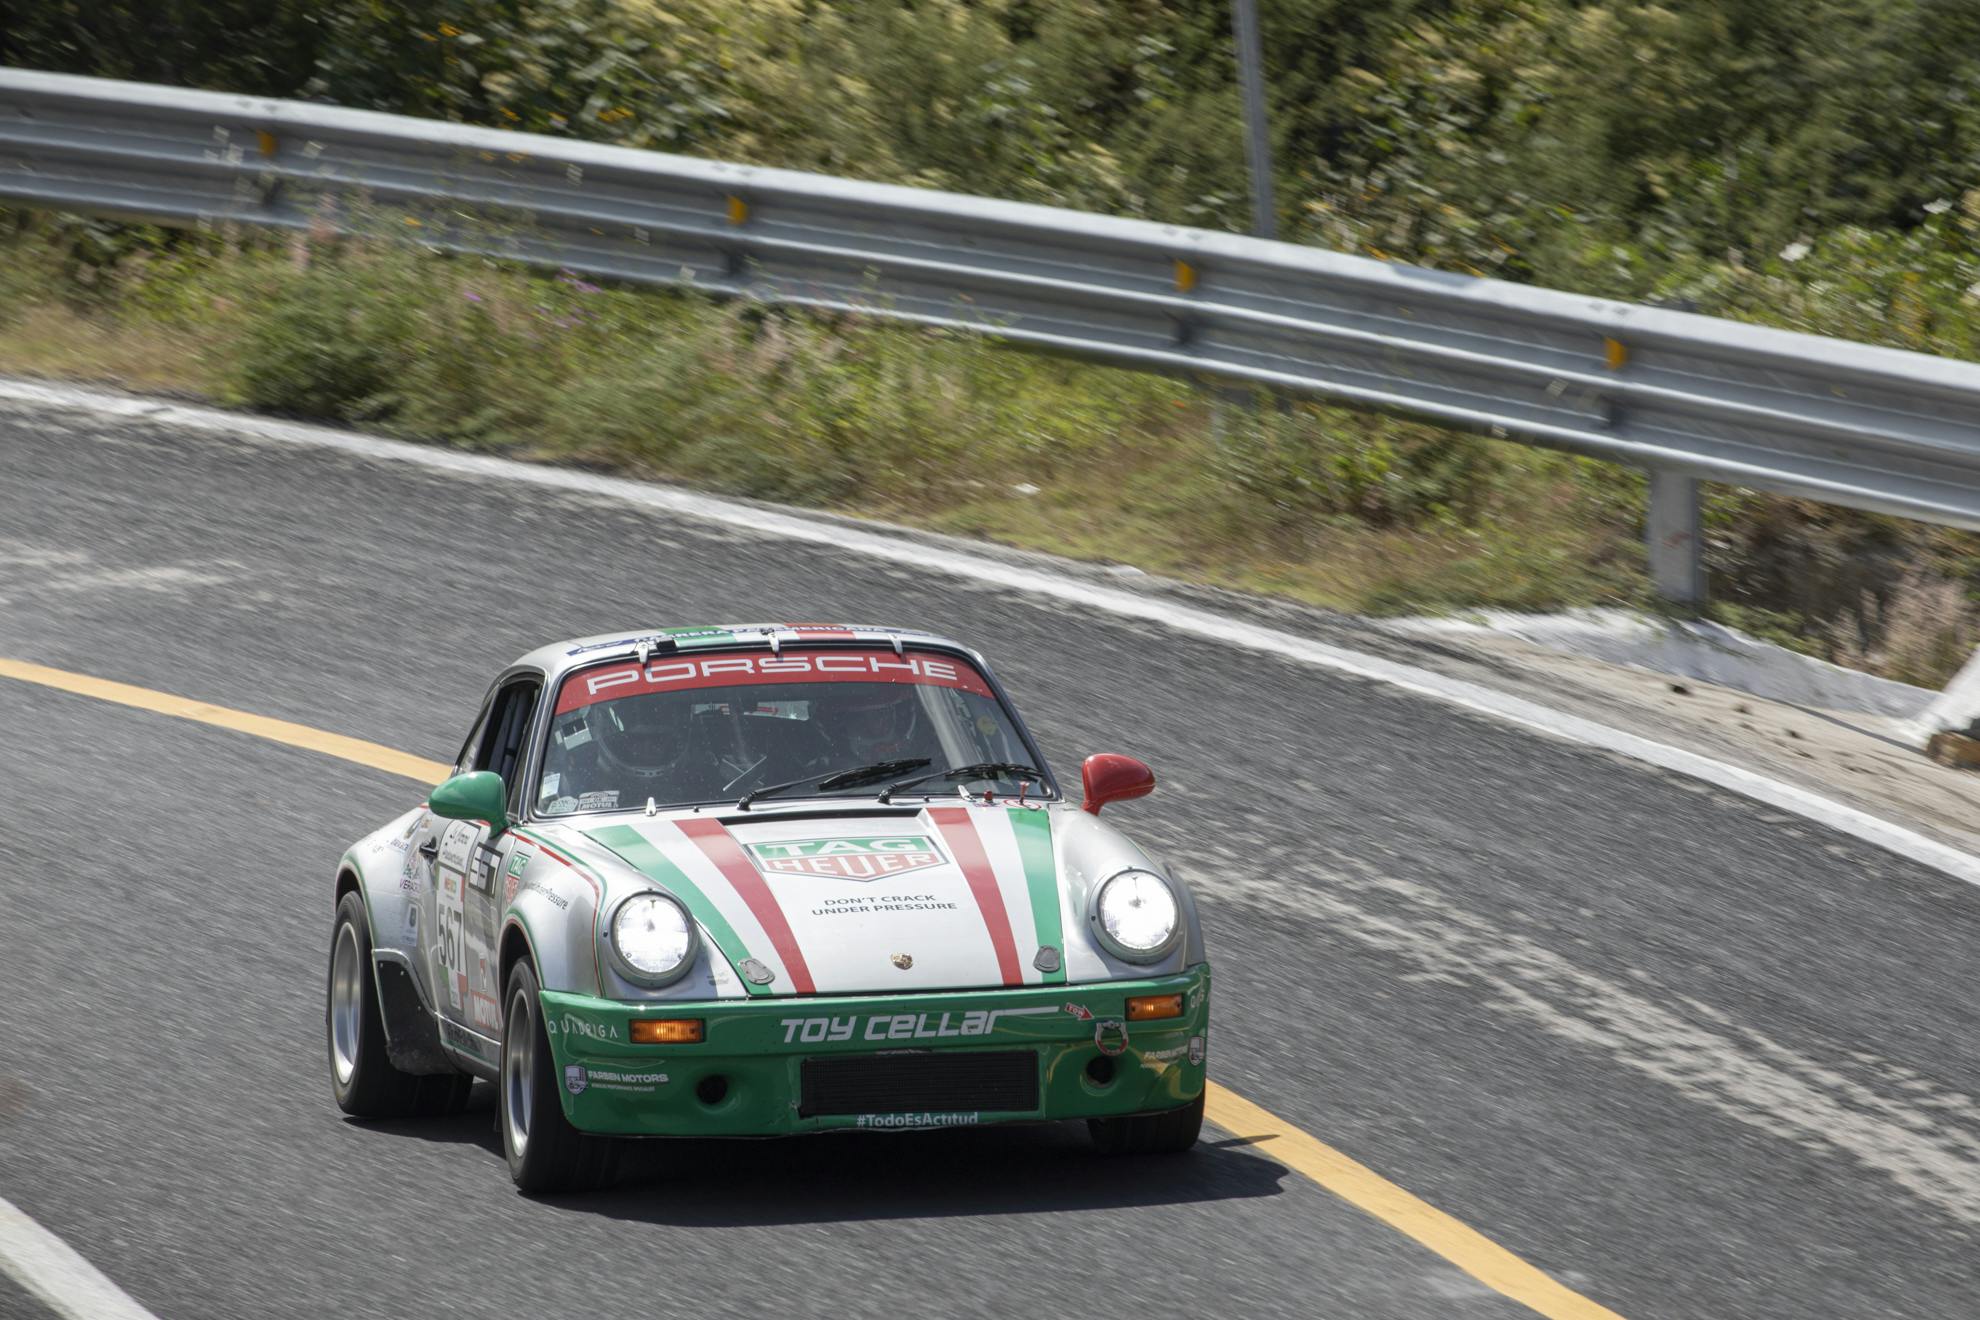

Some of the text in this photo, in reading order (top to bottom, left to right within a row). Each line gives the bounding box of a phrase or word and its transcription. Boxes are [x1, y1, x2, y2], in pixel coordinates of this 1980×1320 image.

[587, 655, 957, 695] PORSCHE
[766, 839, 916, 856] TAG
[508, 855, 528, 876] TAG
[773, 853, 933, 877] HEUER
[824, 894, 936, 906] DON'T CRACK
[812, 902, 958, 916] UNDER PRESSURE
[438, 903, 463, 973] 567
[1066, 1003, 1083, 1016] TOW
[780, 1015, 856, 1043] TOY
[622, 1073, 669, 1083] MOTORS
[857, 1112, 978, 1127] #TodoEsActitud
